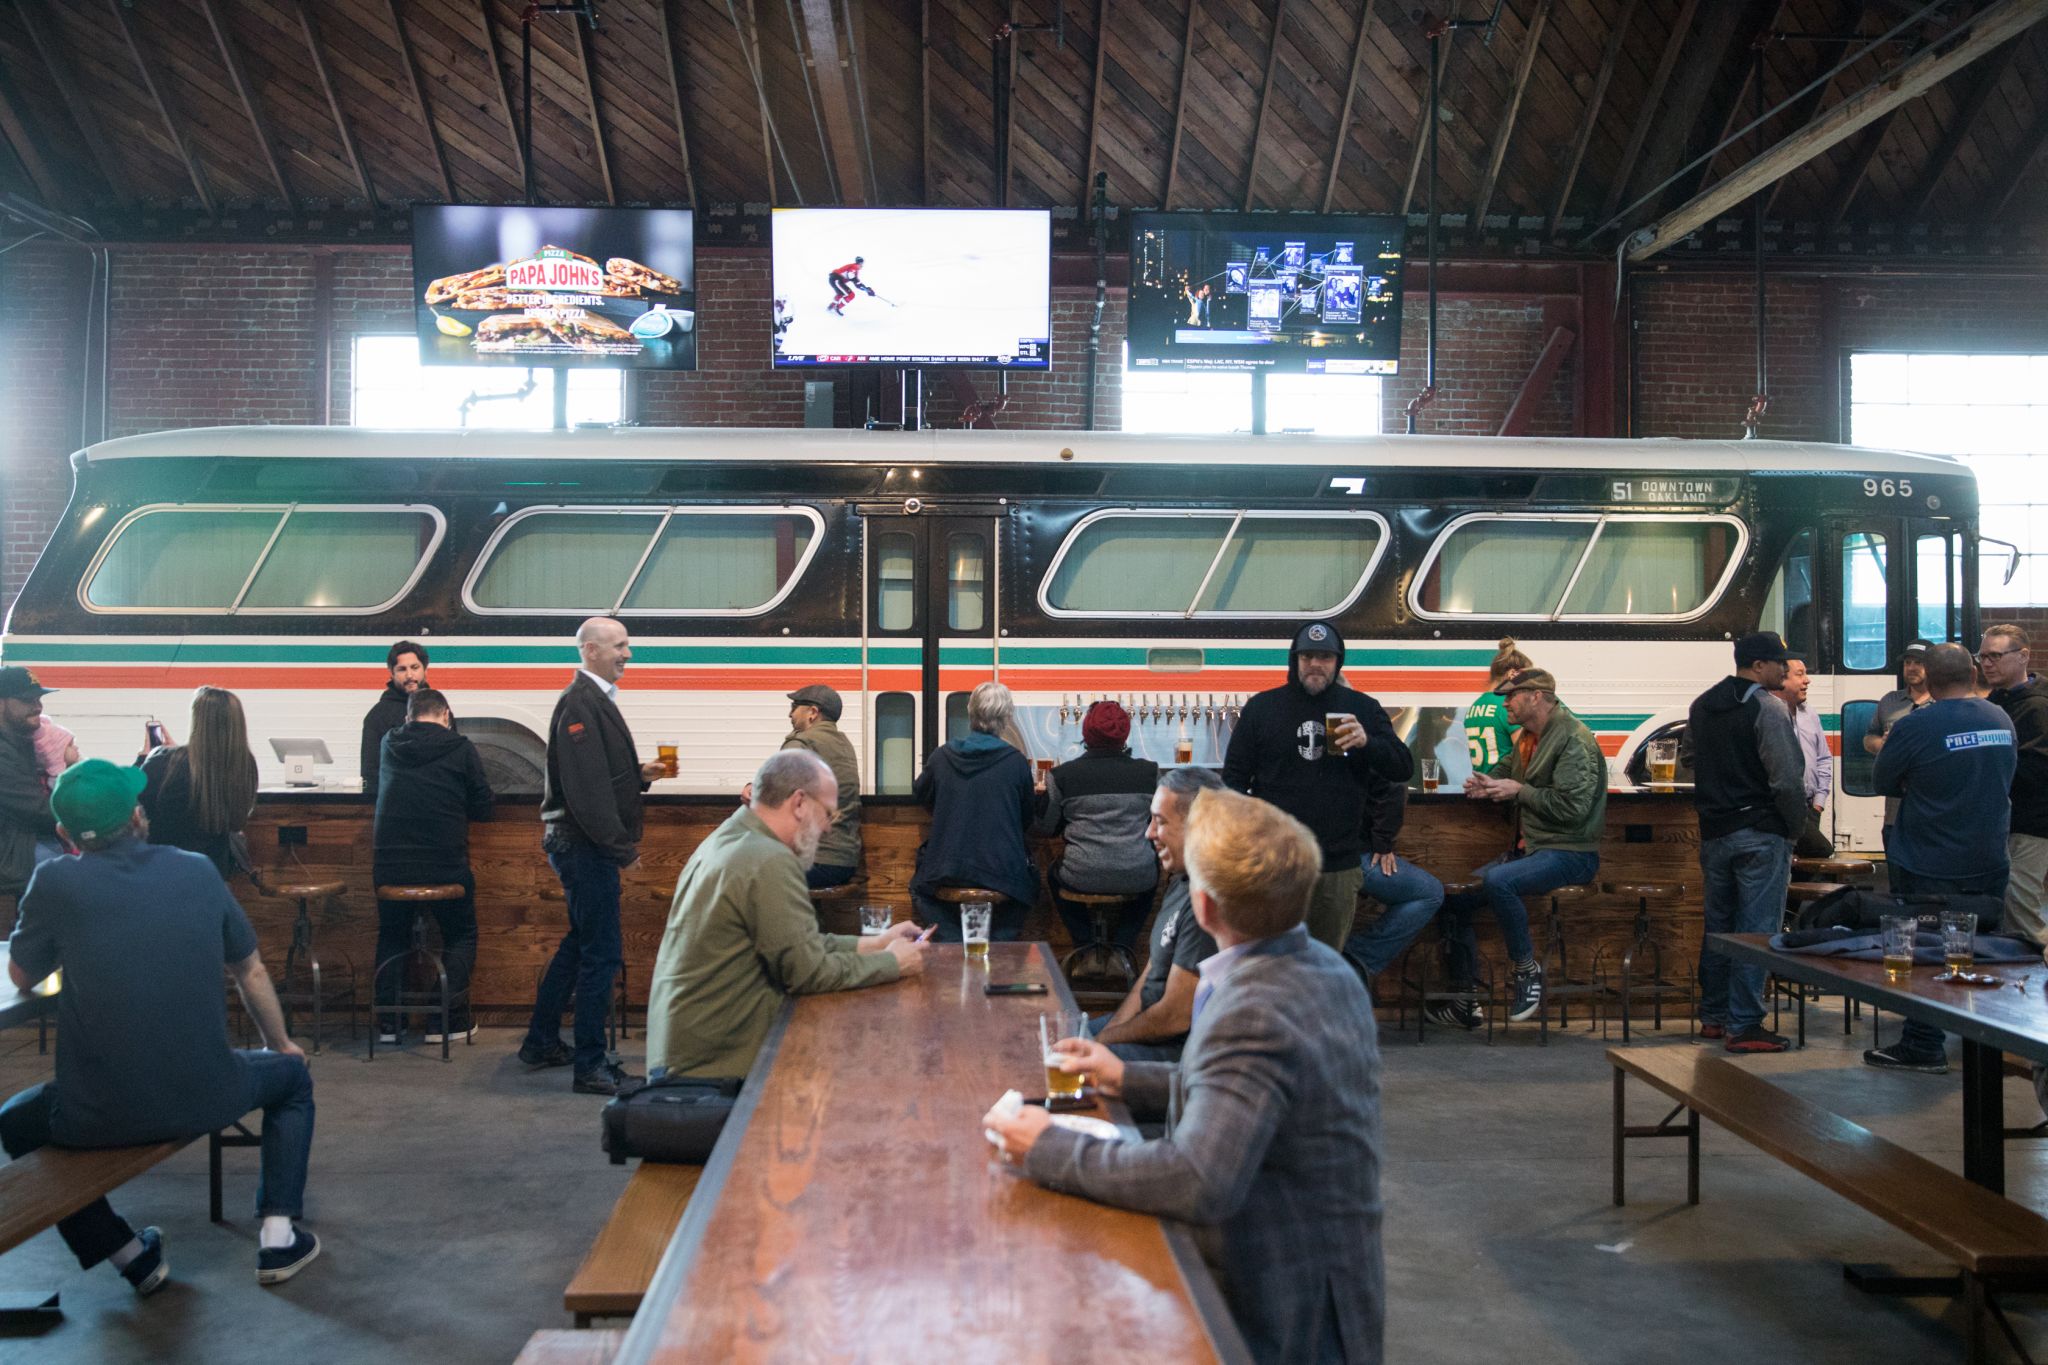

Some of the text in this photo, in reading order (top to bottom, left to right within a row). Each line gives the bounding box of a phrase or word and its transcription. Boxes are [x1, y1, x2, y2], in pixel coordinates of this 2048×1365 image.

[510, 263, 600, 286] PAPA JOHN'S
[1613, 482, 1632, 500] 51
[1641, 482, 1712, 492] DOWNTOWN
[1863, 478, 1913, 497] 965
[1648, 492, 1706, 502] OAKLAND
[1465, 726, 1499, 767] 51
[1946, 734, 1977, 748] PACE
